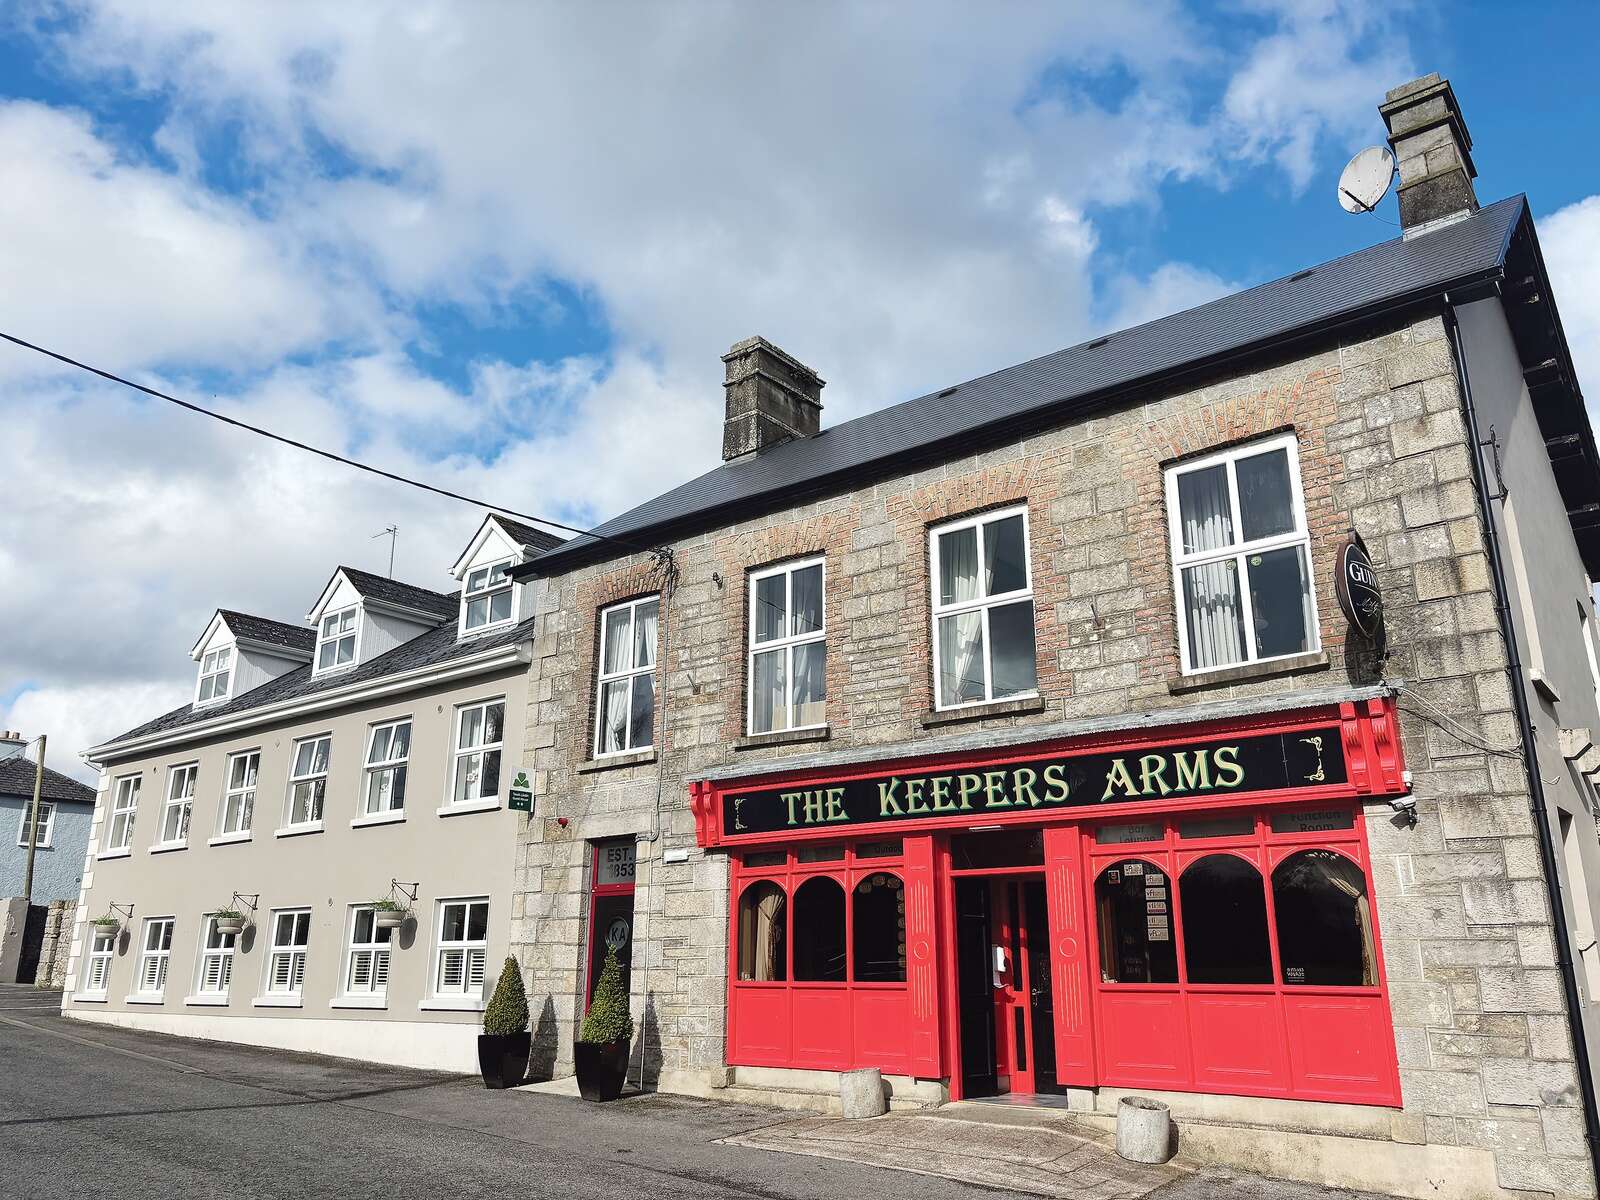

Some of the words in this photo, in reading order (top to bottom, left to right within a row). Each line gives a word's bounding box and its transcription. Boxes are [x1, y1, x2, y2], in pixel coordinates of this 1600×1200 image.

[781, 786, 850, 825] THE
[877, 765, 1071, 817] KEEPERS
[1100, 746, 1246, 802] ARMS
[607, 847, 632, 863] EST.
